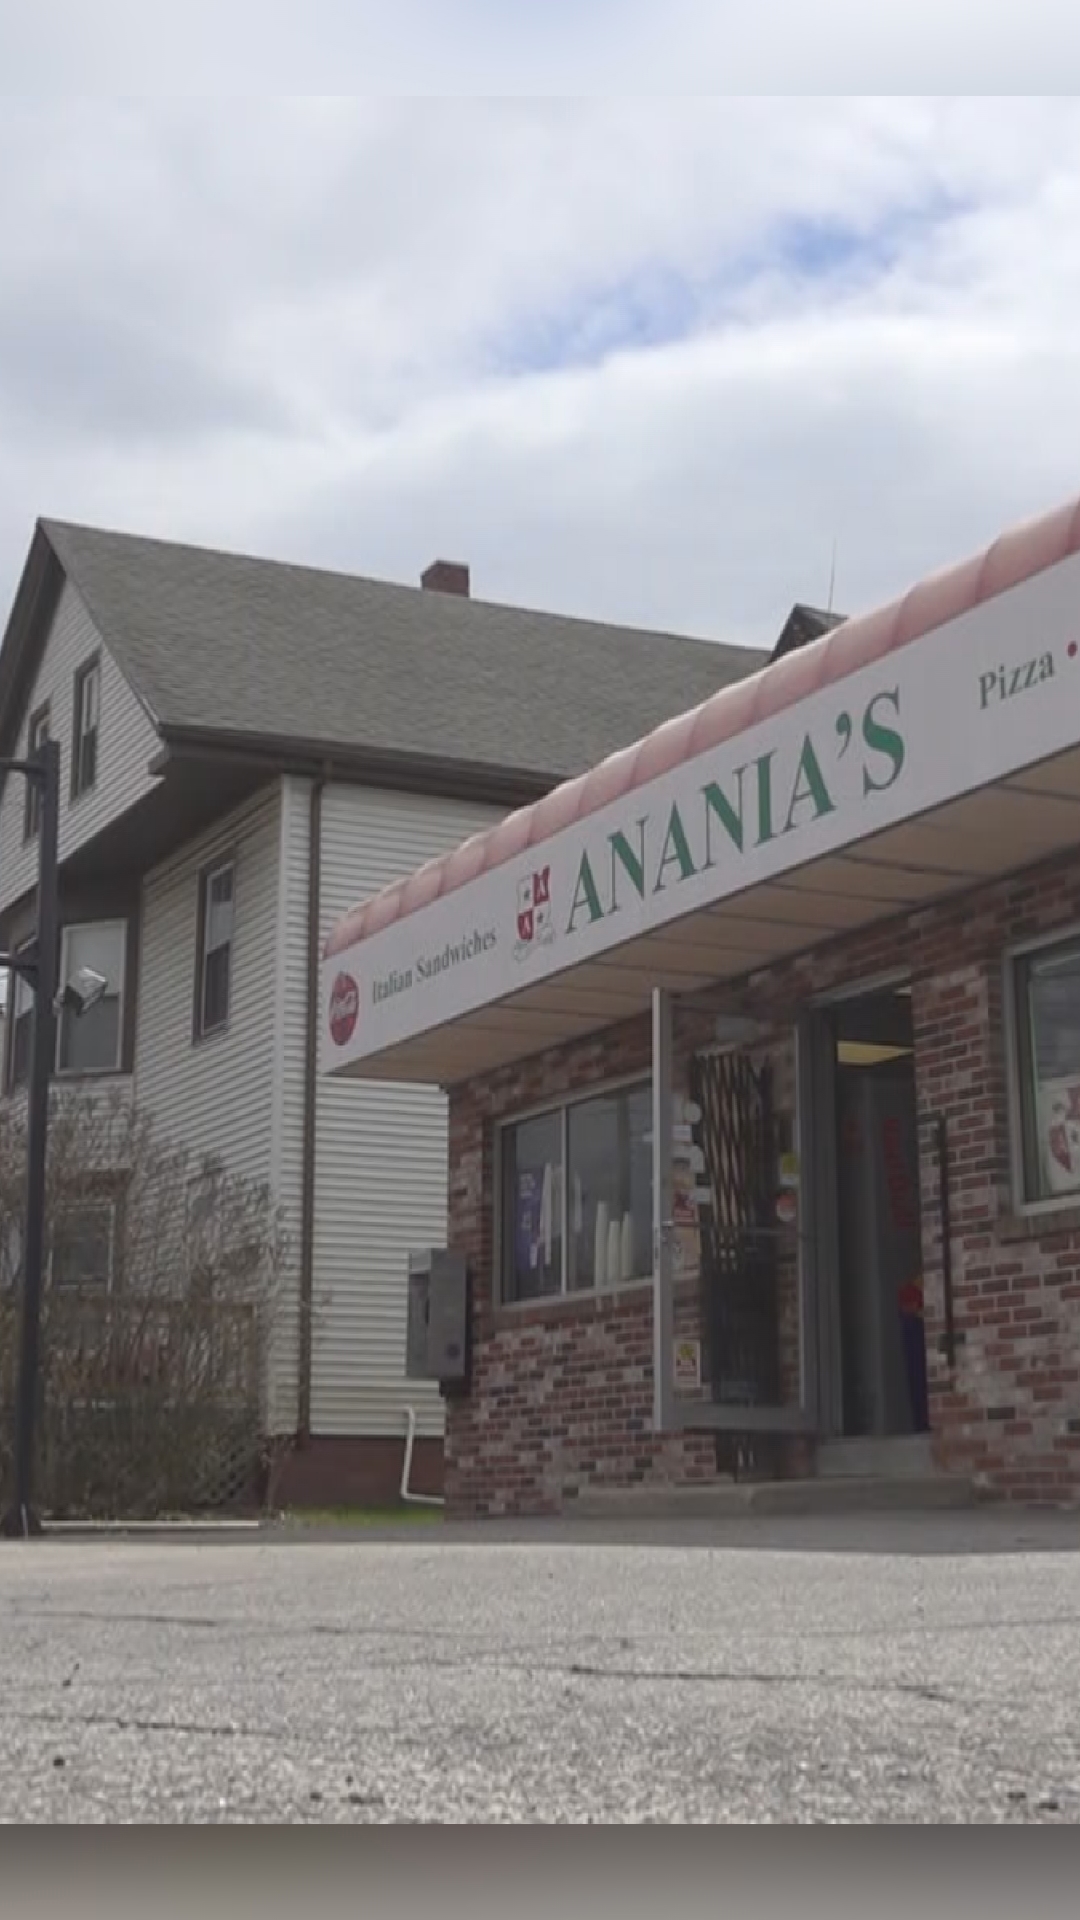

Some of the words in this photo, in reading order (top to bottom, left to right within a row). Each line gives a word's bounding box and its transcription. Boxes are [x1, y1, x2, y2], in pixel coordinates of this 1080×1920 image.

[978, 650, 1055, 709] Pizza
[566, 685, 906, 934] ANANIA'S
[372, 970, 413, 1004] Italian
[416, 927, 498, 983] Sandwiches
